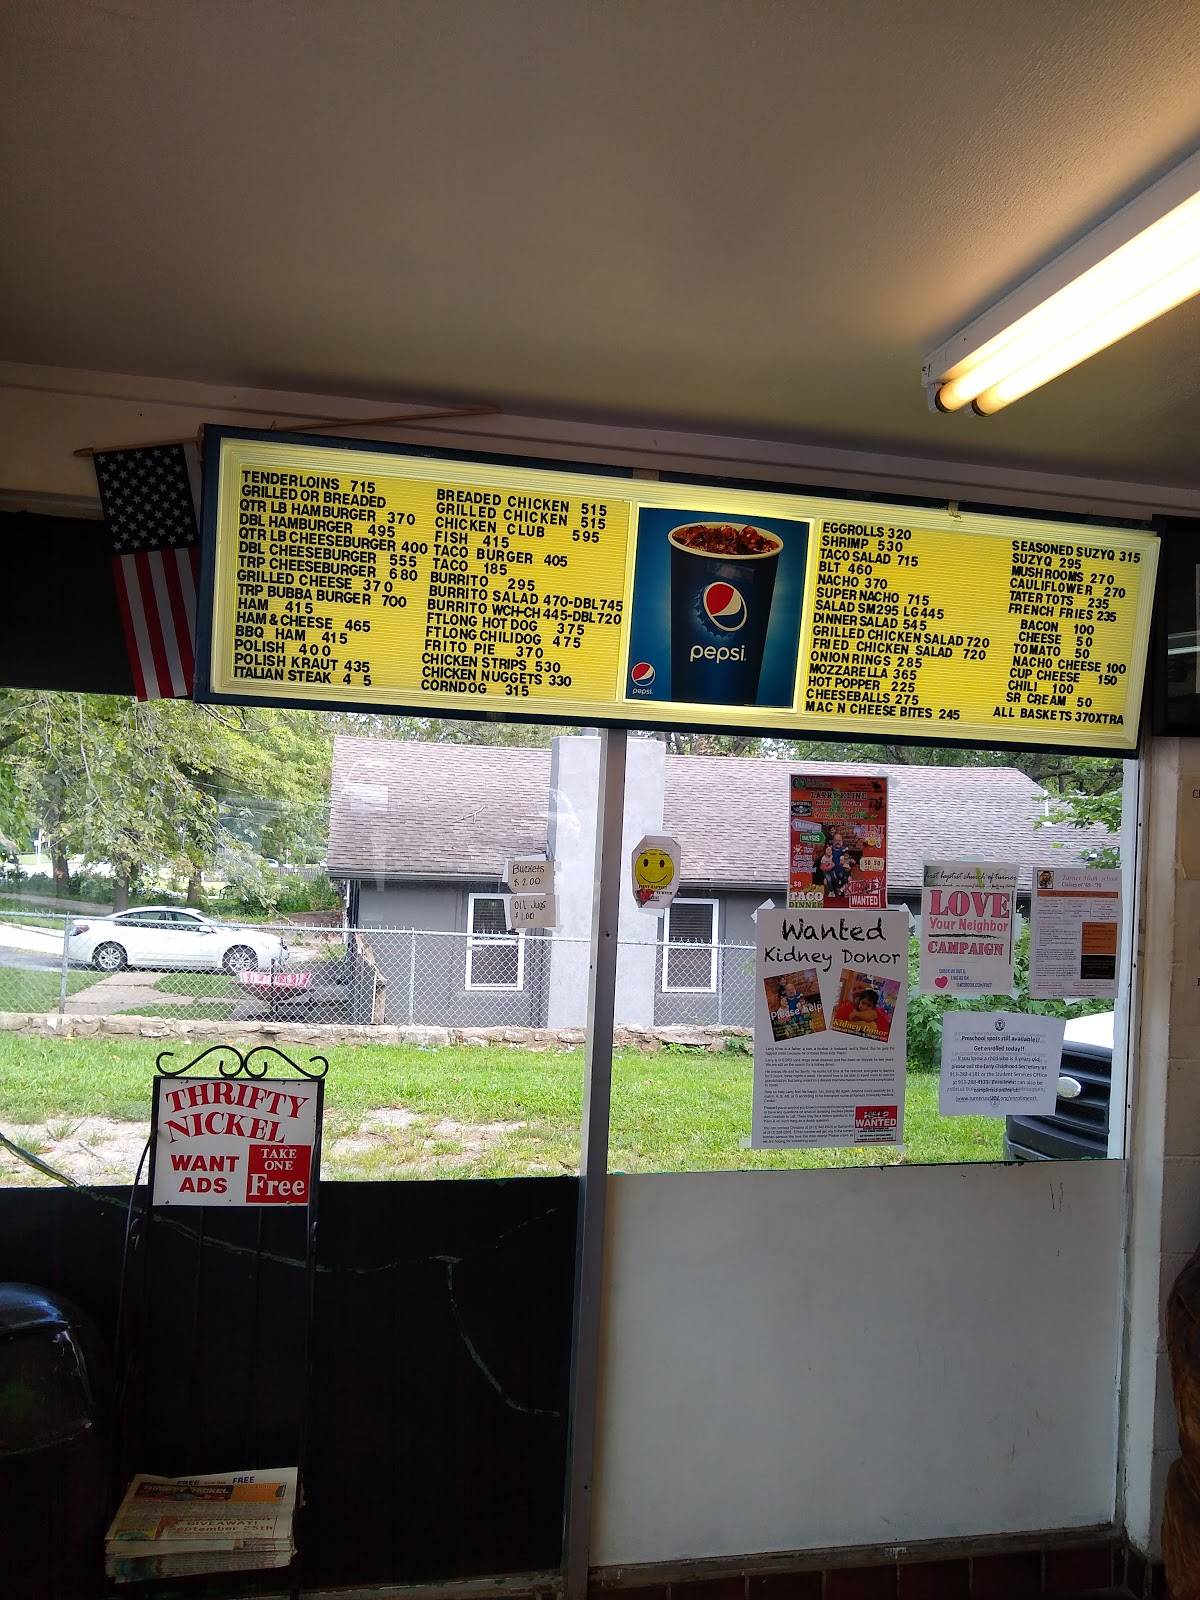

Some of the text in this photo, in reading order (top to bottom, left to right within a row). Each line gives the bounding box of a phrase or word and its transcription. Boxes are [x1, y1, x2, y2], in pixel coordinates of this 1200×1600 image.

[242, 470, 375, 494] TENDERLOINS 715
[242, 484, 386, 508] GRILLED OR BREADED
[437, 489, 606, 516] BREADED CHICKEN 515
[240, 499, 415, 525] QTR LB HAMBURGER 370
[435, 516, 599, 543] CHICKEN CLUB 595
[823, 522, 911, 540] EGGROLLS 320
[239, 527, 428, 554] QTR LB CHEESEBURGER 400
[435, 531, 509, 548] FISH 415
[822, 535, 902, 552] SHRIMP 530
[434, 544, 567, 567] TACO BURGER 405
[820, 548, 918, 566] TACO SALAD 715
[1012, 541, 1140, 563] SEASONED SUZYQ 315
[819, 561, 872, 575] BLT 460
[1012, 566, 1114, 585] MUSHROOMS 270
[237, 569, 392, 592] GRILLED CHEESE 370
[431, 572, 534, 591] BURRITO 295
[818, 574, 887, 589] NACHO 370
[238, 584, 406, 608] TRP BUBBA BURGER 700
[1010, 590, 1109, 609] TATER TOTS 235
[238, 598, 313, 614] HAM 415
[237, 611, 370, 632] HAM & CHEESE 465
[427, 612, 584, 635] FTLONG HOT DOG 375
[1021, 619, 1094, 635] BACON 100
[813, 625, 989, 648] GRILLED CHICKEN SALAD 720
[425, 639, 543, 658] FRITO PIE 370
[690, 645, 745, 663] pepsi
[235, 653, 370, 673] POLISH KRAUT 435
[422, 653, 560, 673] CHICKEN STRIPS 530
[811, 651, 922, 668] ONION RINGS 285
[1013, 656, 1126, 674] NACHO CHEESE 100
[810, 663, 916, 680] MOZZARELLA 365
[421, 679, 529, 696] CORNDOG 315
[1008, 680, 1073, 694] CHILI 100
[806, 688, 918, 705] CHEESEBALLS 275
[806, 701, 960, 720] MAC N CHEESE BITES 245
[993, 707, 1124, 725] ALL BASKETS 370XTRA
[940, 870, 963, 882] baptist
[789, 892, 823, 900] TACO
[851, 896, 878, 906] WANTED
[929, 890, 1010, 918] LOVE
[782, 917, 886, 942] Wanted
[930, 917, 1008, 933] Your Neighbor
[928, 940, 1004, 956] CAMPAIGN
[764, 946, 900, 972] Kidney Donor
[770, 1003, 823, 1020] Please help
[832, 1019, 862, 1032] Kidney
[864, 1025, 888, 1036] Donor
[166, 1082, 310, 1118] THRIFTY
[164, 1111, 286, 1144] NICKEL
[855, 1118, 896, 1127] WANTED
[261, 1148, 296, 1158] TAKE
[171, 1154, 240, 1172] WANT
[264, 1160, 293, 1170] ONE
[178, 1177, 228, 1194] ADS
[248, 1174, 305, 1196] Free
[232, 1476, 256, 1485] FREE
